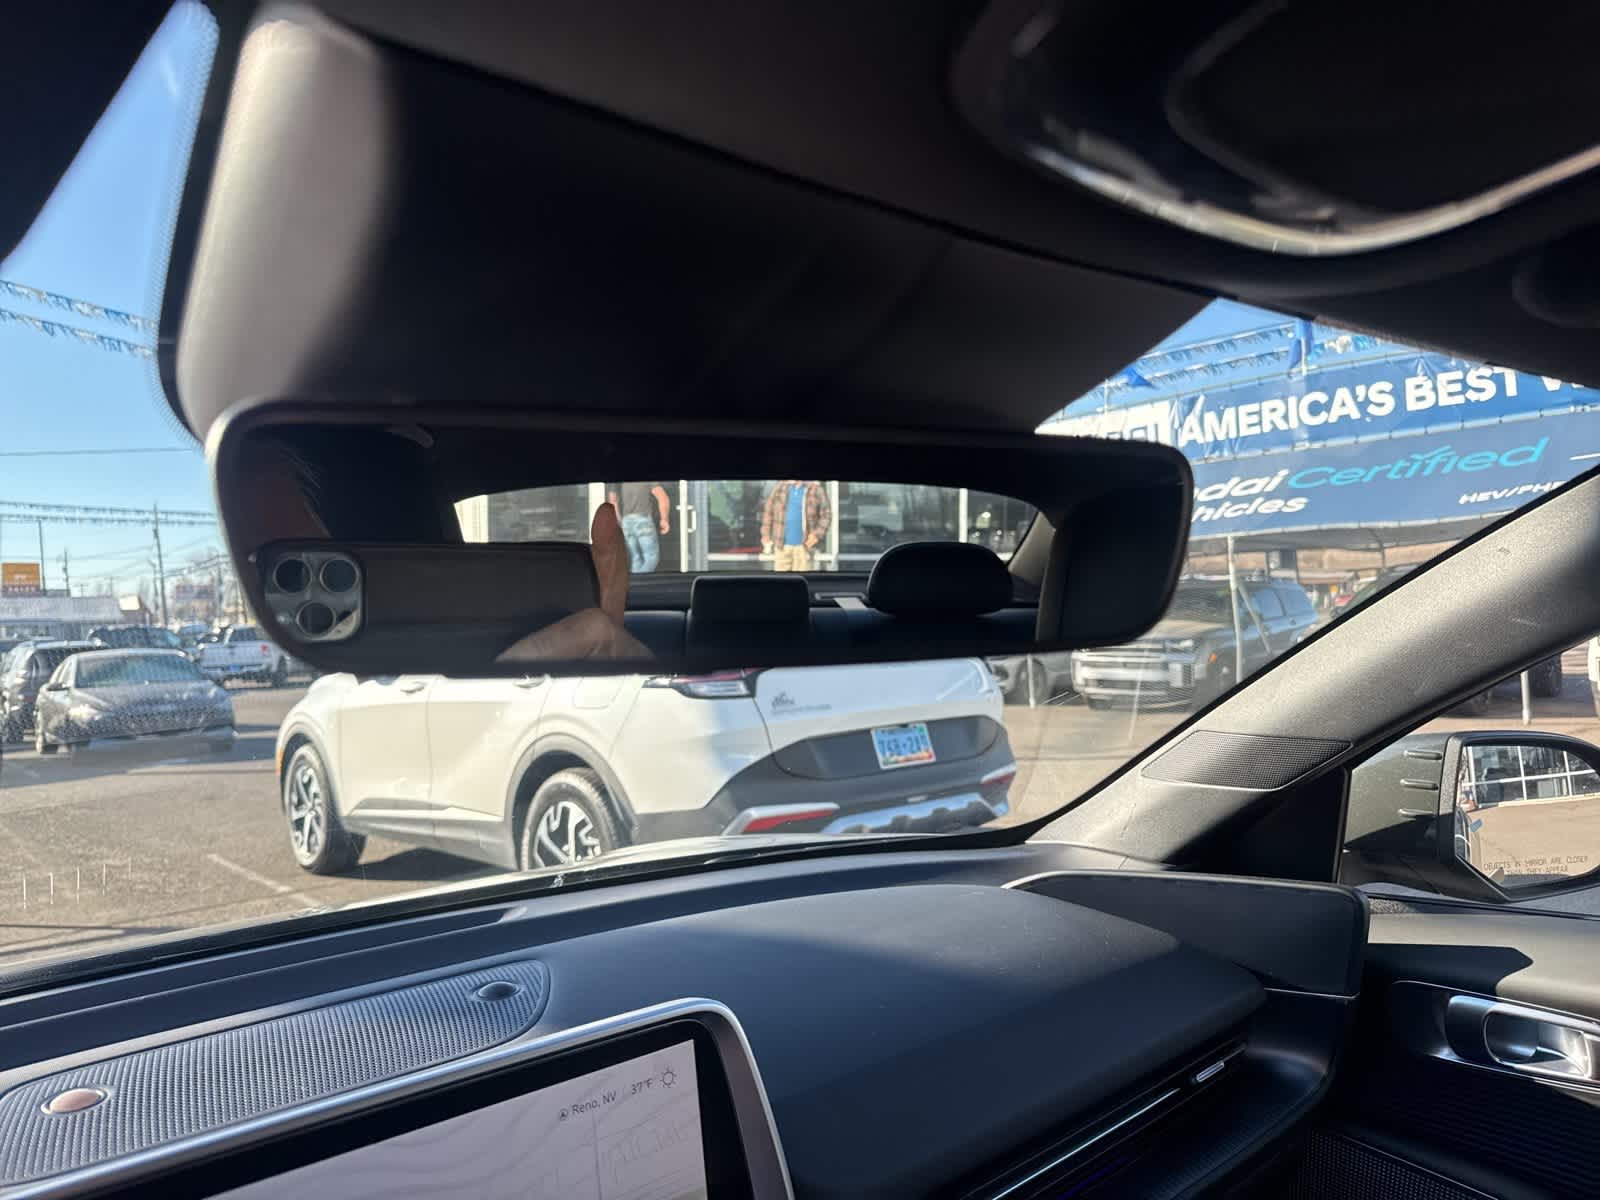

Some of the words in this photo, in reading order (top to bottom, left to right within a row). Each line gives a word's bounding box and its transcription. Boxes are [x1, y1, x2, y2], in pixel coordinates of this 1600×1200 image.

[1178, 380, 1396, 447] AMERICA'S
[1405, 366, 1518, 411] BEST
[1287, 437, 1549, 488] Certified
[572, 1100, 601, 1115] Reno,
[602, 1091, 617, 1105] NV
